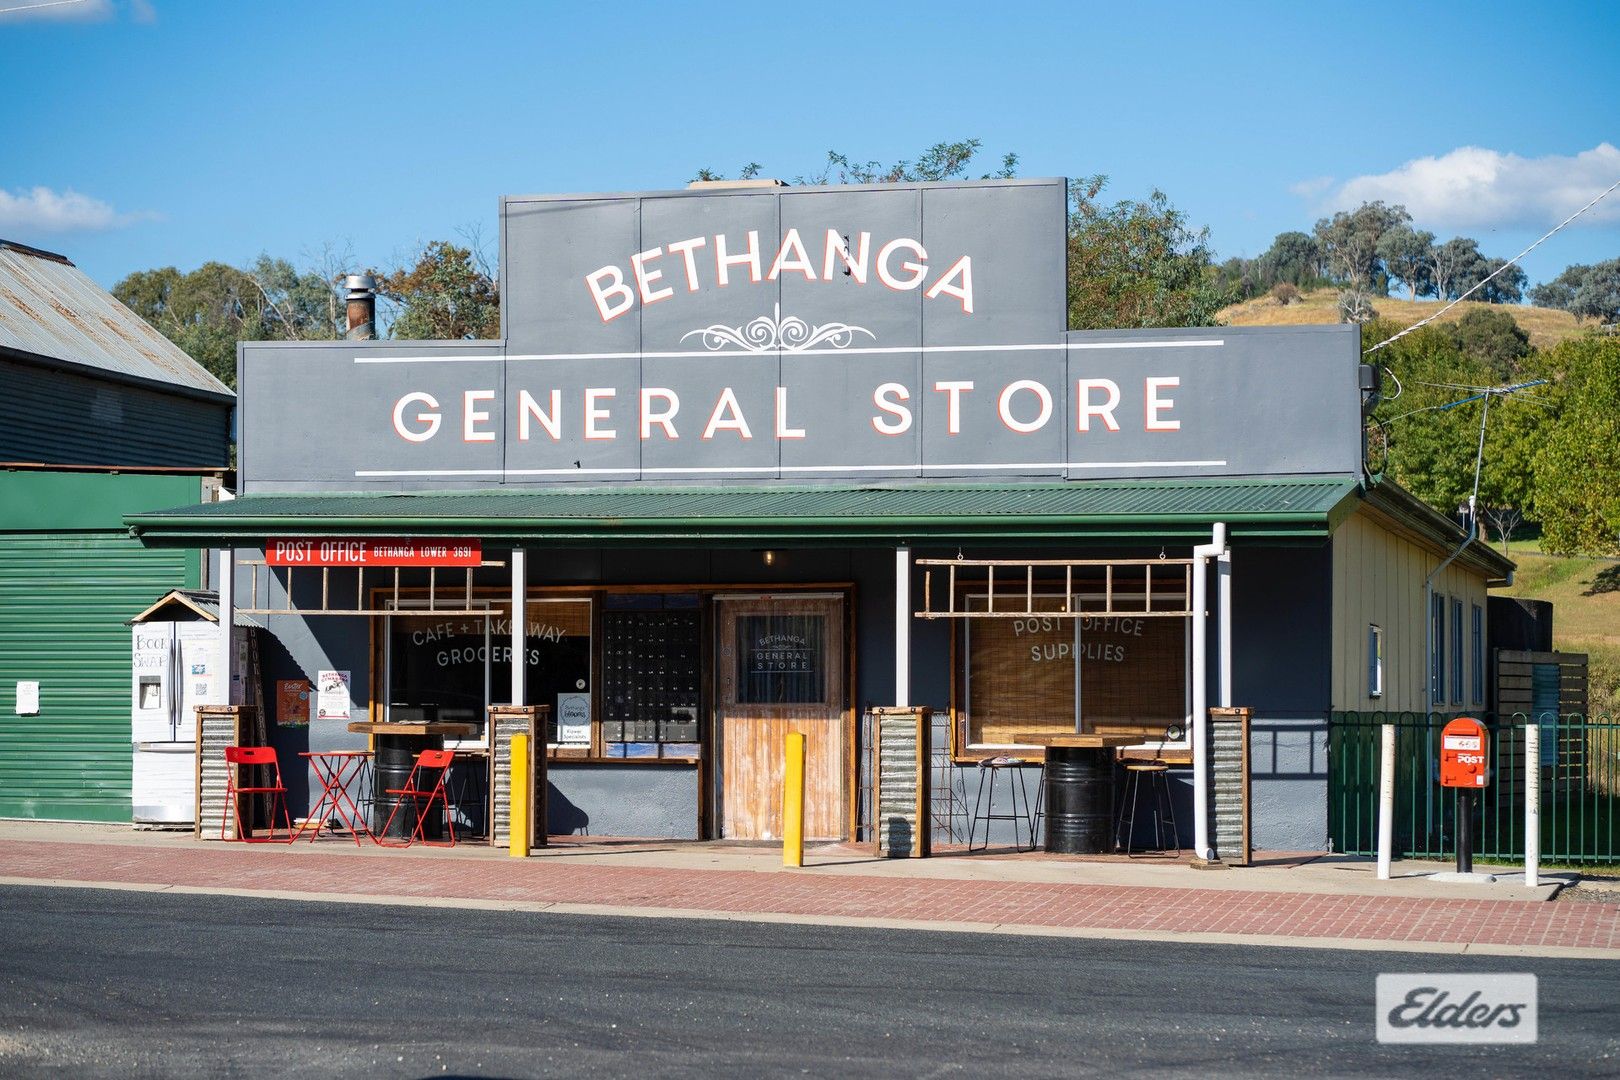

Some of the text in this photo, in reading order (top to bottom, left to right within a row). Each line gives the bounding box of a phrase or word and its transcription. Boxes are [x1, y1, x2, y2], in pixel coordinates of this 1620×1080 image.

[585, 228, 974, 323] BETHANGA
[392, 376, 1181, 443] GENERAL STORE
[276, 541, 471, 562] POST OFFICE BETHANGA LOWER 3691
[412, 622, 455, 646] CAFE
[1013, 616, 1145, 637] POST OFFICE
[759, 634, 806, 646] BETHANGA
[436, 646, 540, 667] GROCERS
[756, 652, 808, 660] GENERAL
[1031, 643, 1125, 662] SUPPLIES
[757, 661, 807, 670] STORE
[1457, 755, 1485, 764] POST
